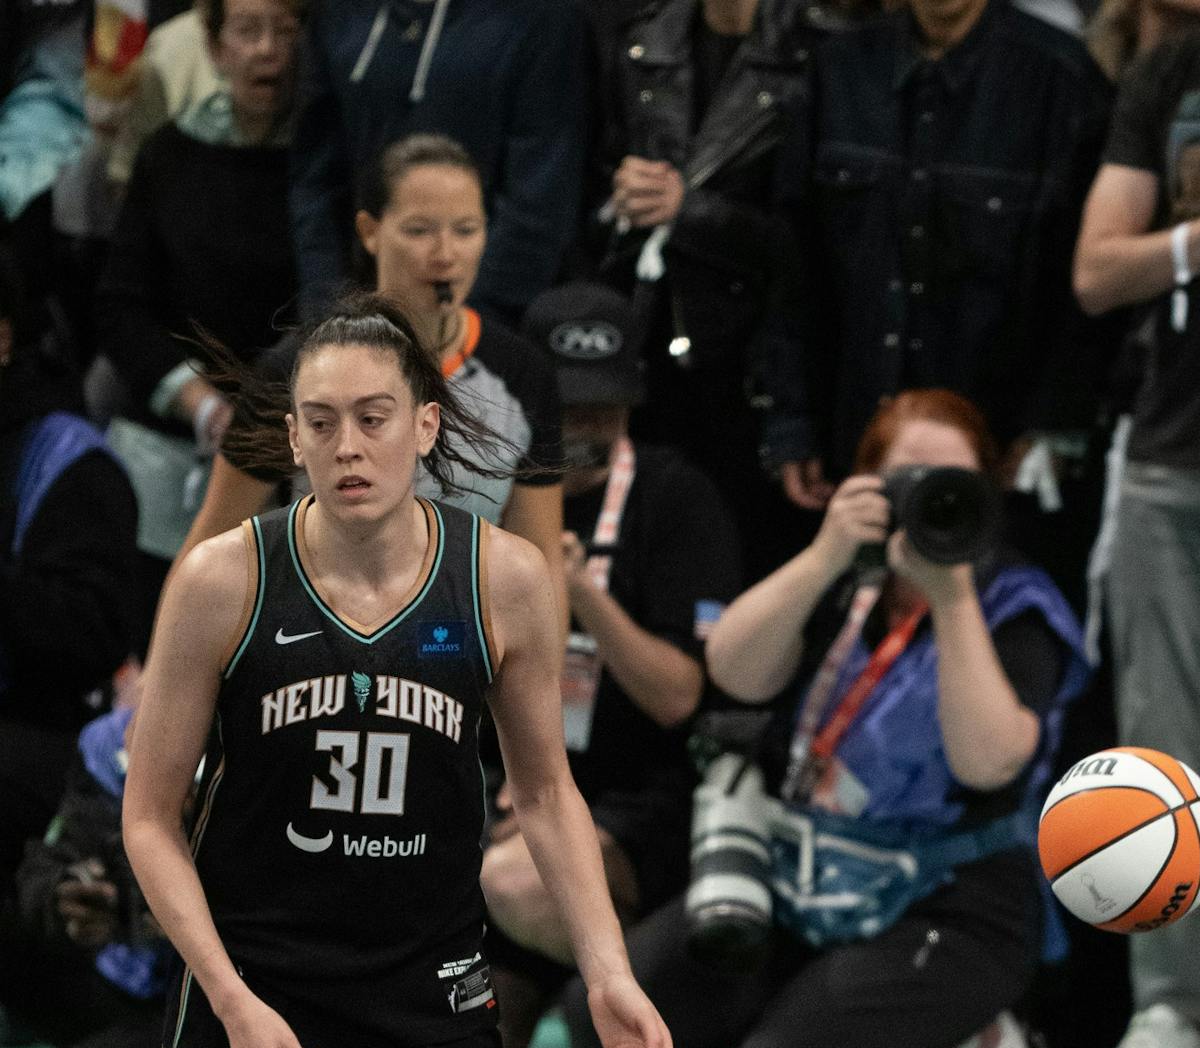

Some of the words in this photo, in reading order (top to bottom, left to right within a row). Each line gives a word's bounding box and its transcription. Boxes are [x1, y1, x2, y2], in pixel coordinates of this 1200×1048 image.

[422, 643, 460, 652] BARCLAYS
[261, 674, 347, 735] NEW
[376, 674, 464, 744] YORK
[309, 730, 411, 815] 30
[343, 834, 426, 857] Webull
